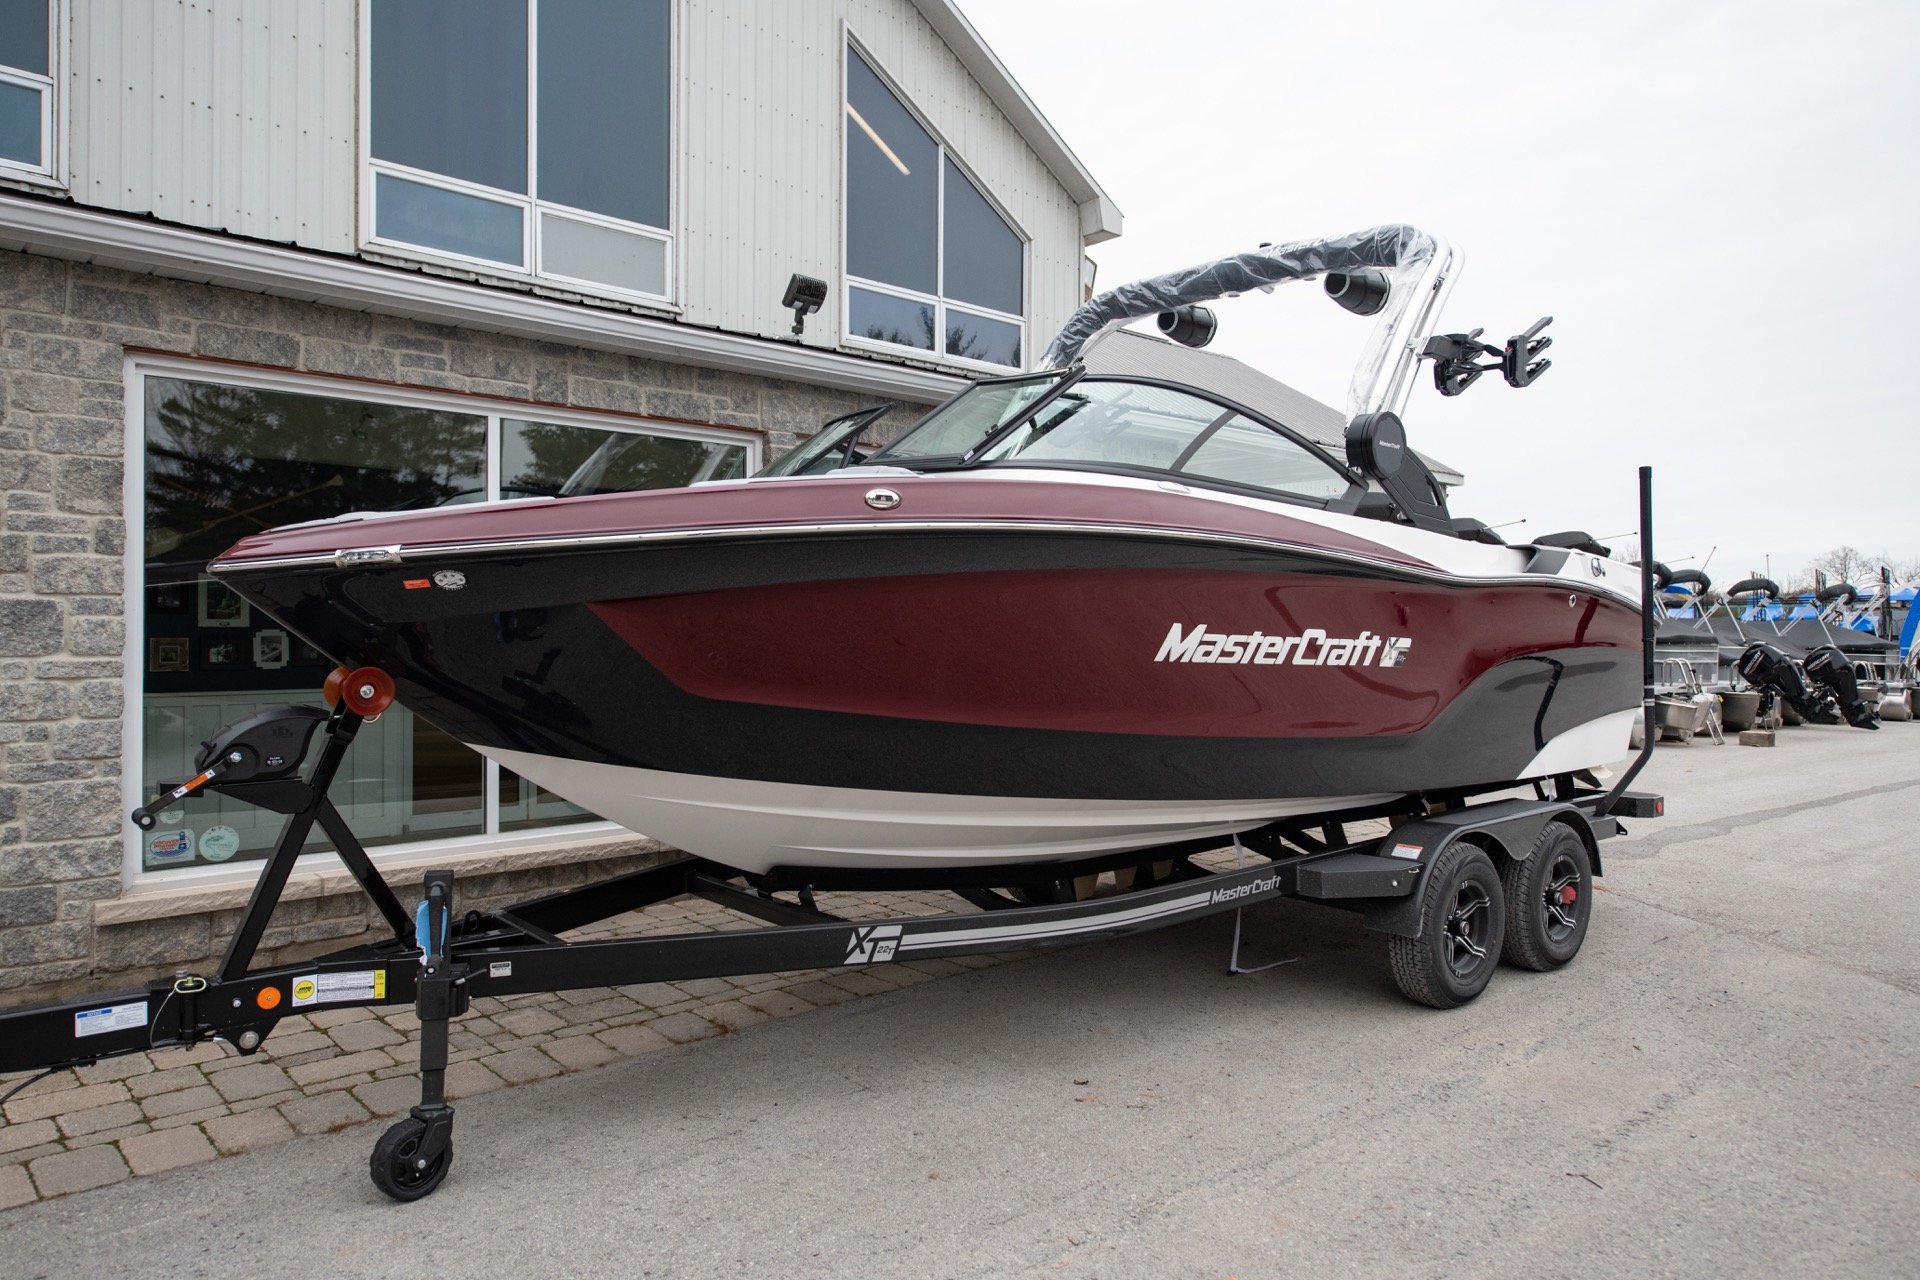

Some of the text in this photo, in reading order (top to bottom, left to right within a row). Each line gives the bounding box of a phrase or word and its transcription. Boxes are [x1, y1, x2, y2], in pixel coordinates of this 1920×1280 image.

[1154, 623, 1382, 666] MasterCraft
[1743, 650, 1761, 675] MERCURY
[1806, 652, 1830, 671] MERCURY
[1211, 875, 1281, 904] MasterCraft
